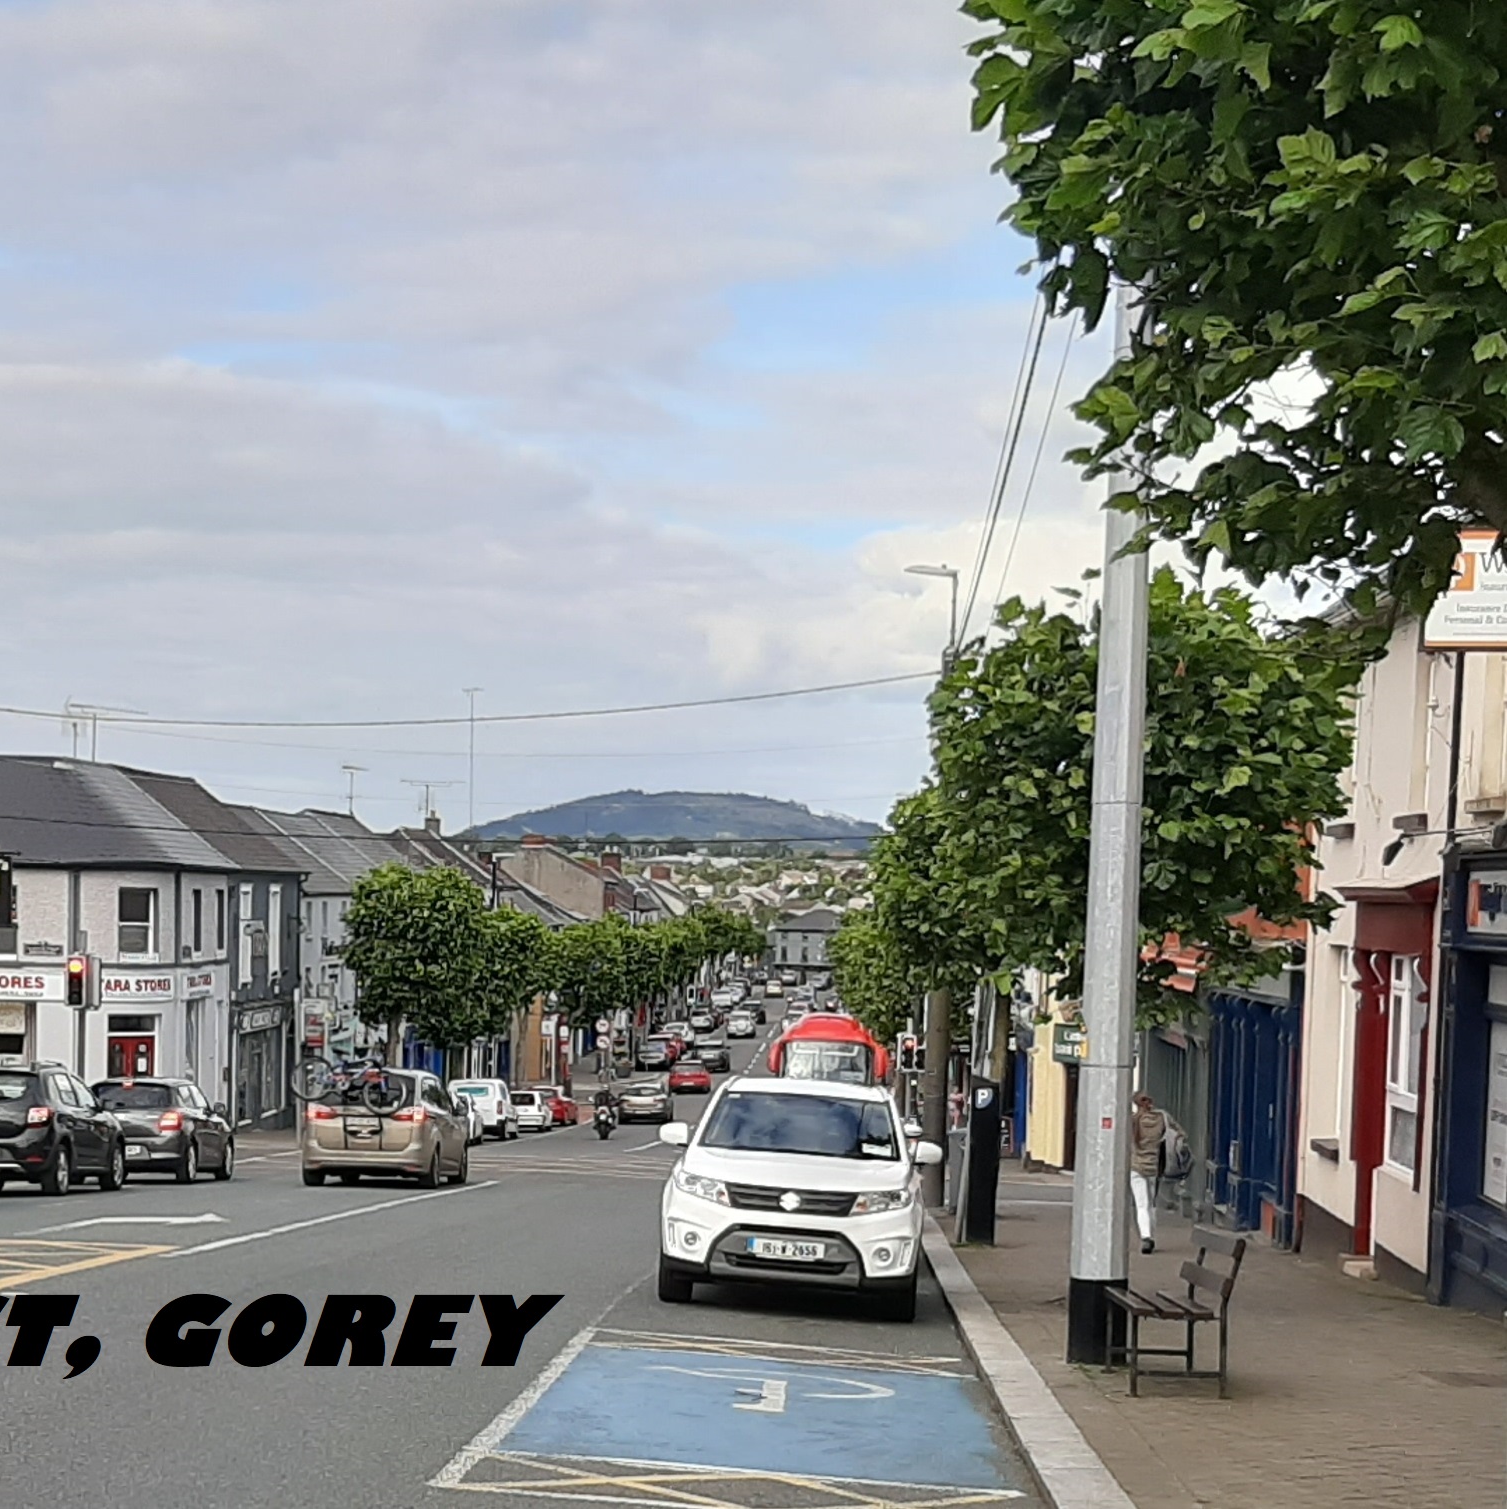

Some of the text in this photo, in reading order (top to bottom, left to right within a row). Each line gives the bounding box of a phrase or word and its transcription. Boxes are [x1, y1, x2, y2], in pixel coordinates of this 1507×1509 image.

[101, 978, 130, 992] ARA
[135, 978, 171, 992] STORES
[977, 1089, 988, 1105] P
